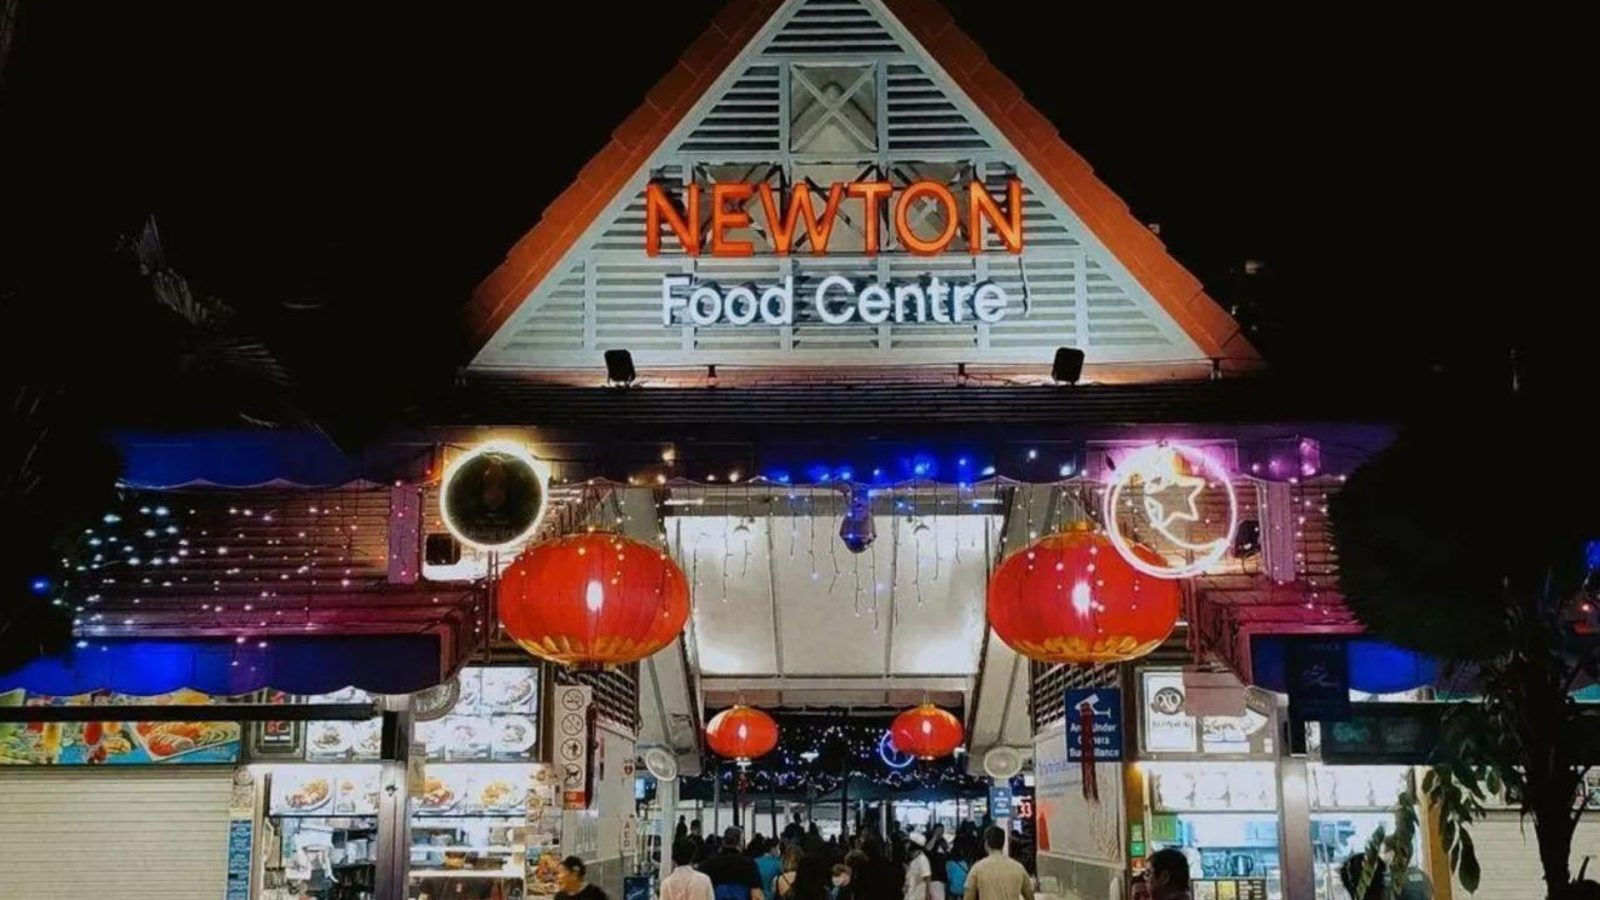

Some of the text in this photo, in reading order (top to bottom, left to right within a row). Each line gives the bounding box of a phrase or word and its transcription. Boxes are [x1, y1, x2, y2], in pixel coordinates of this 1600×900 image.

[645, 179, 1024, 257] NEWTON
[662, 274, 1008, 326] Food Centre
[1077, 735, 1110, 745] Cera
